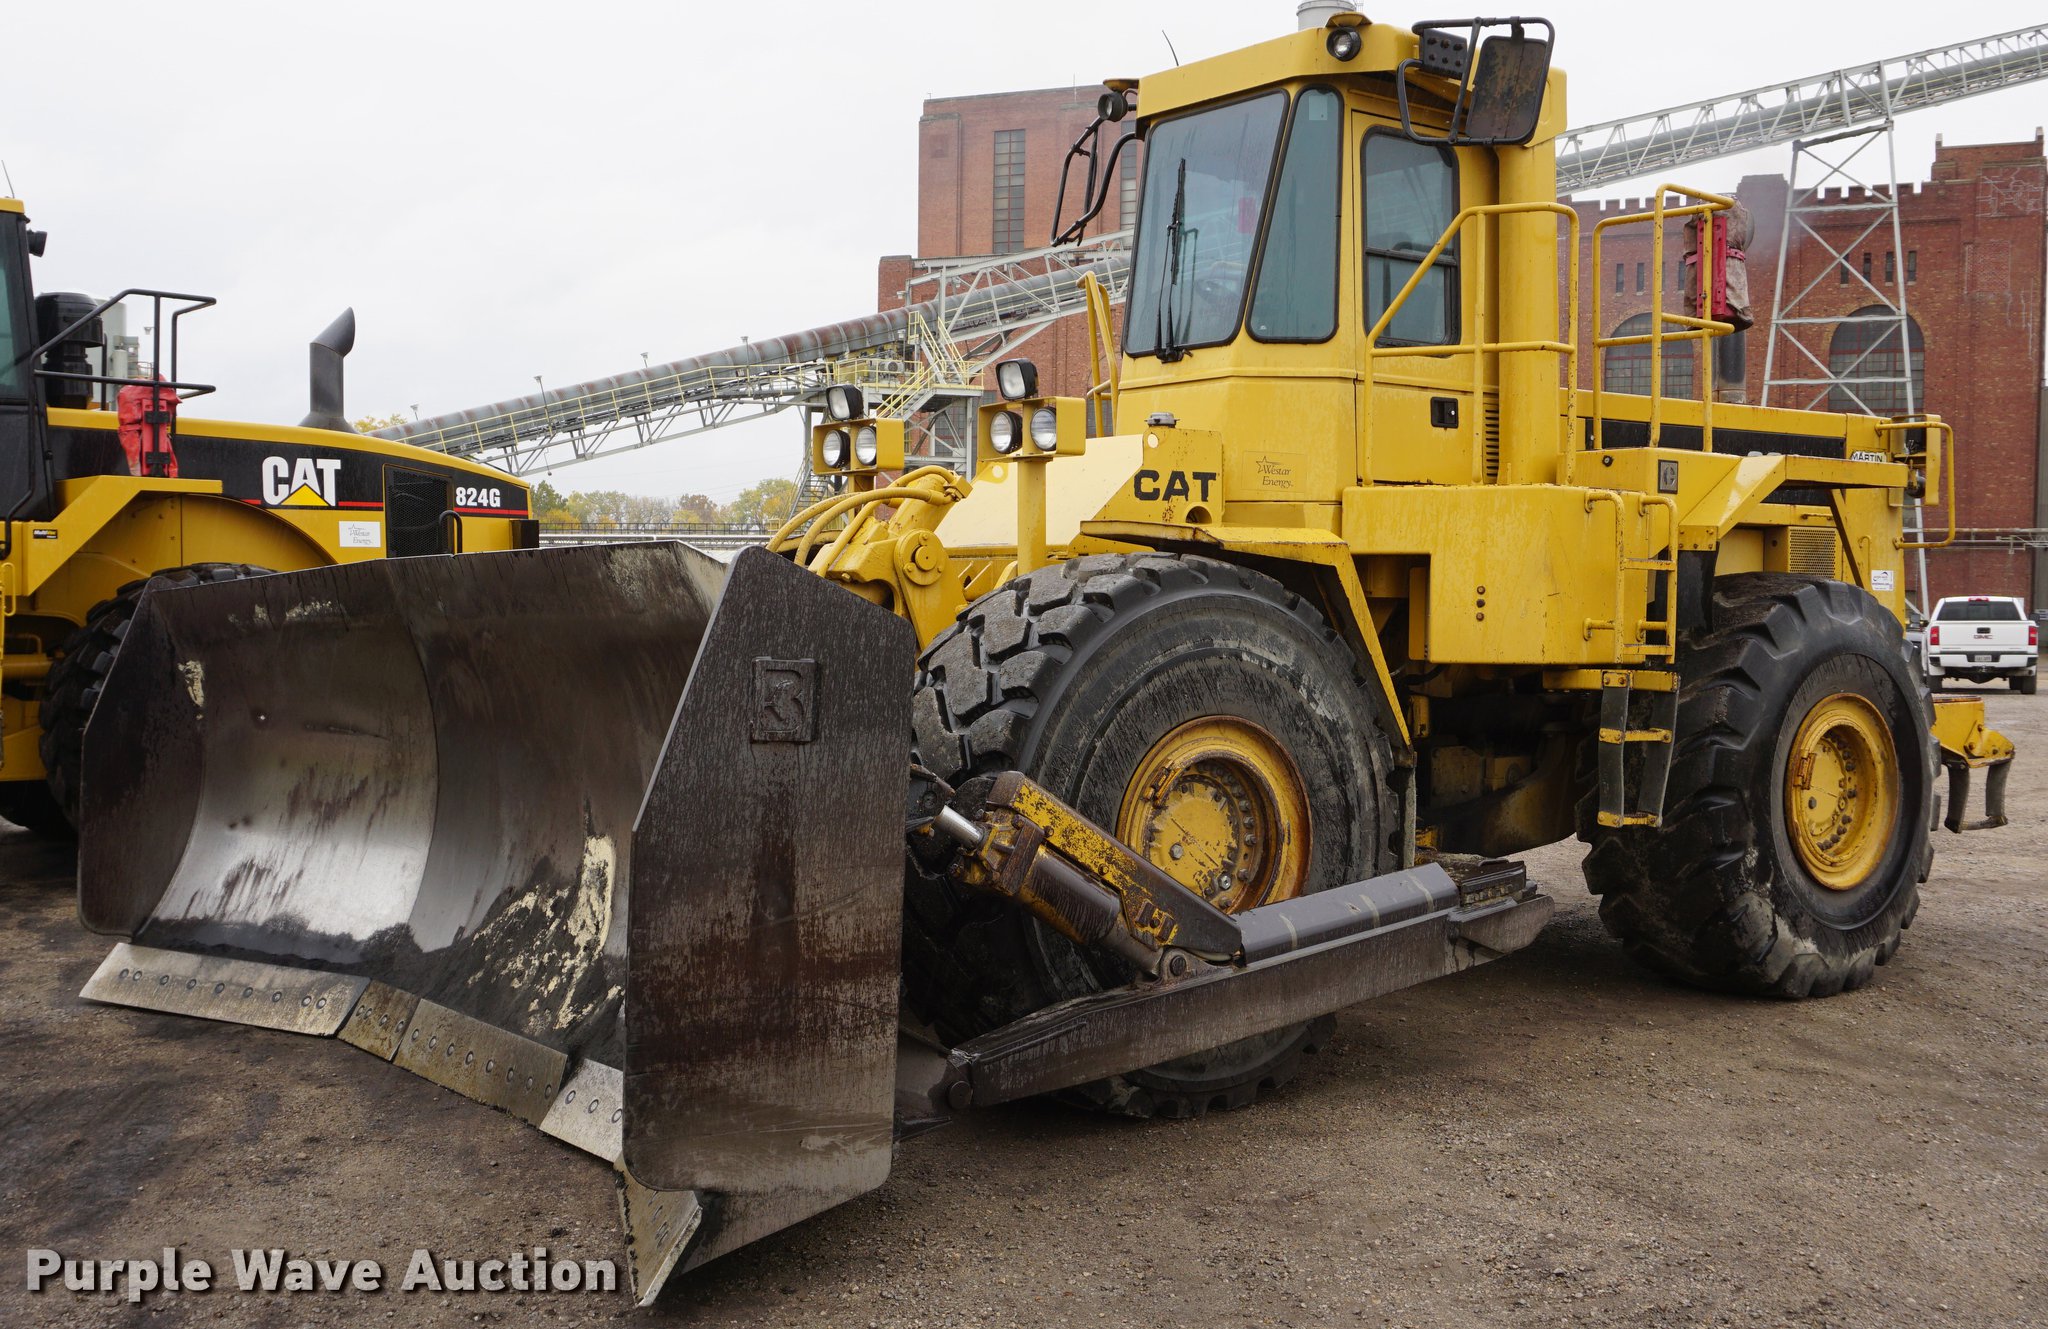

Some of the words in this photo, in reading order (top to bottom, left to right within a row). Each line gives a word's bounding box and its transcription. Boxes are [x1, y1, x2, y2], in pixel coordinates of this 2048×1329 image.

[262, 456, 341, 506] CAT
[1263, 464, 1291, 476] Westar
[456, 487, 501, 507] 824G
[1134, 470, 1216, 502] CAT
